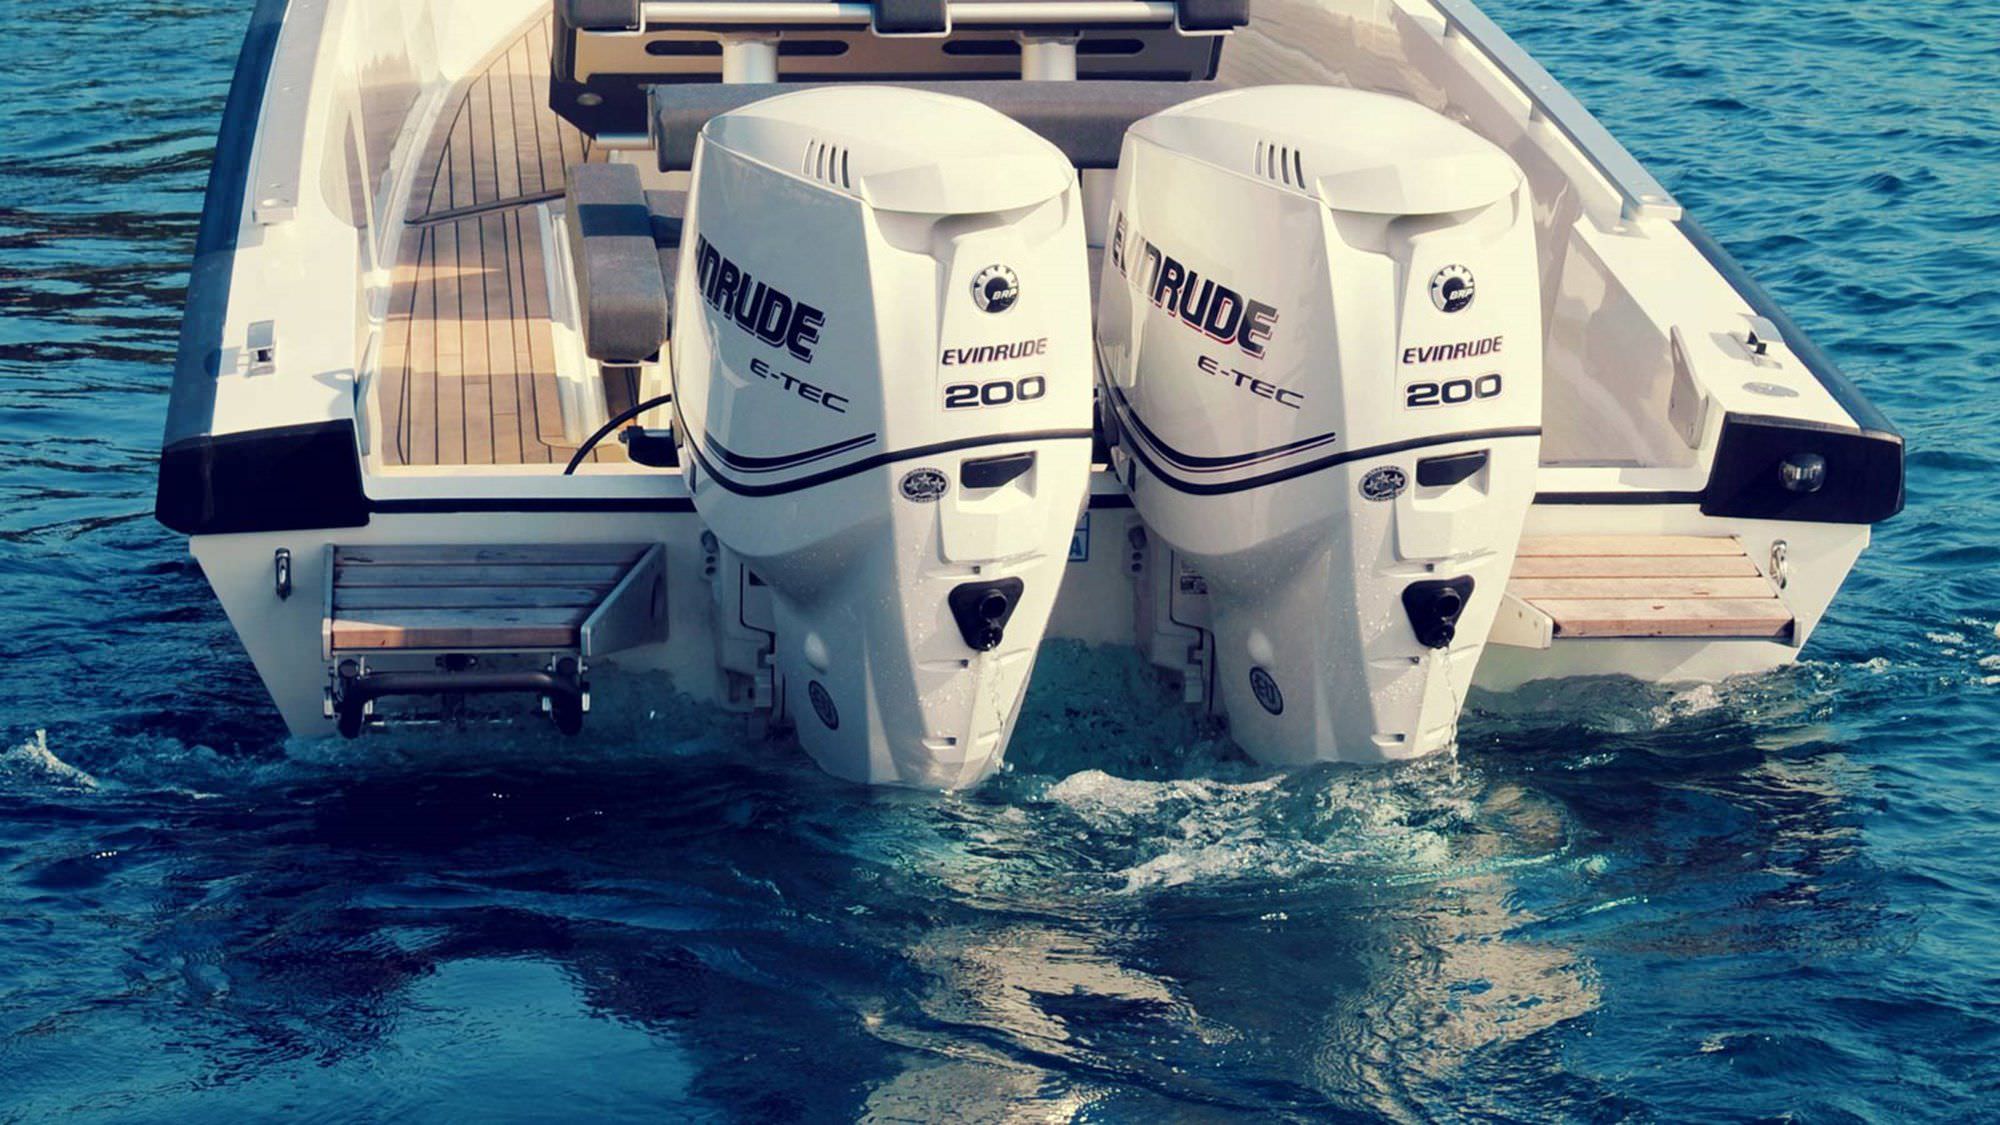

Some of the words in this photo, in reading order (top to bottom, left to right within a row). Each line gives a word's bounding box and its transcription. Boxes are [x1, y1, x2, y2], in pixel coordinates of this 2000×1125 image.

[696, 231, 826, 364] INRUDE
[942, 337, 1048, 366] EVINRUDE
[1402, 335, 1504, 365] EVINRUDE
[750, 357, 849, 414] E-TEC
[944, 374, 1046, 409] 200
[1197, 354, 1304, 410] E-TEC
[1406, 373, 1502, 408] 200
